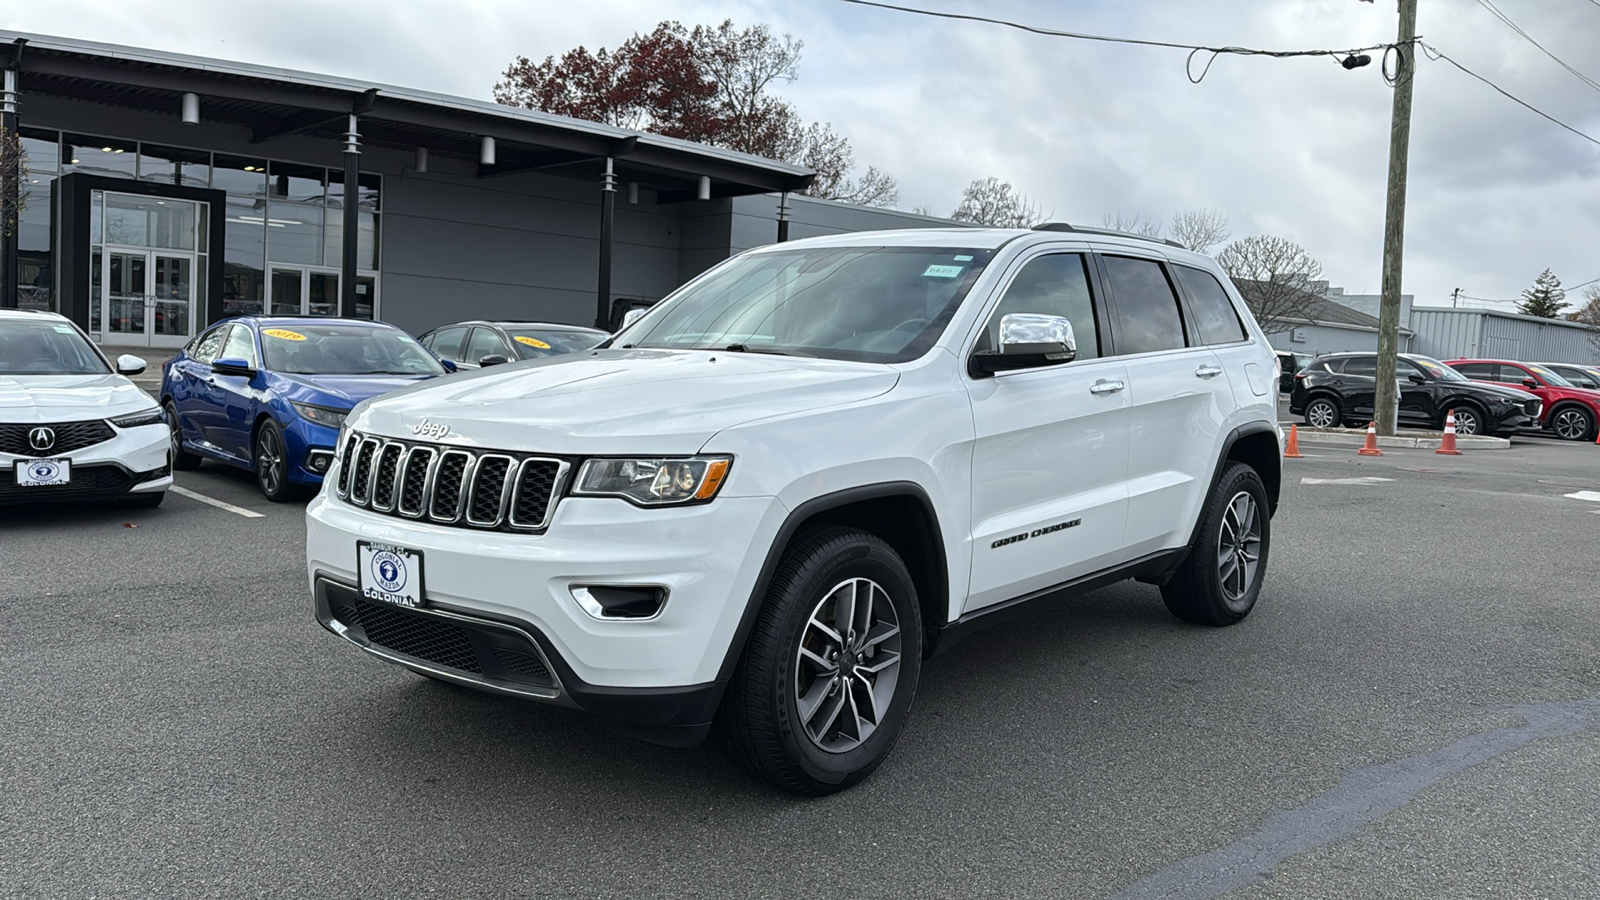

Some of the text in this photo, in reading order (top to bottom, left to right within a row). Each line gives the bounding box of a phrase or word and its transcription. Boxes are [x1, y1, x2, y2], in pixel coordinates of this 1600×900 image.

[412, 417, 451, 440] Jeep
[991, 517, 1082, 549] GRAND CHEROKEE
[375, 553, 402, 570] COLONIAL
[379, 577, 400, 589] MAZDA
[364, 590, 415, 607] COLONIAL
